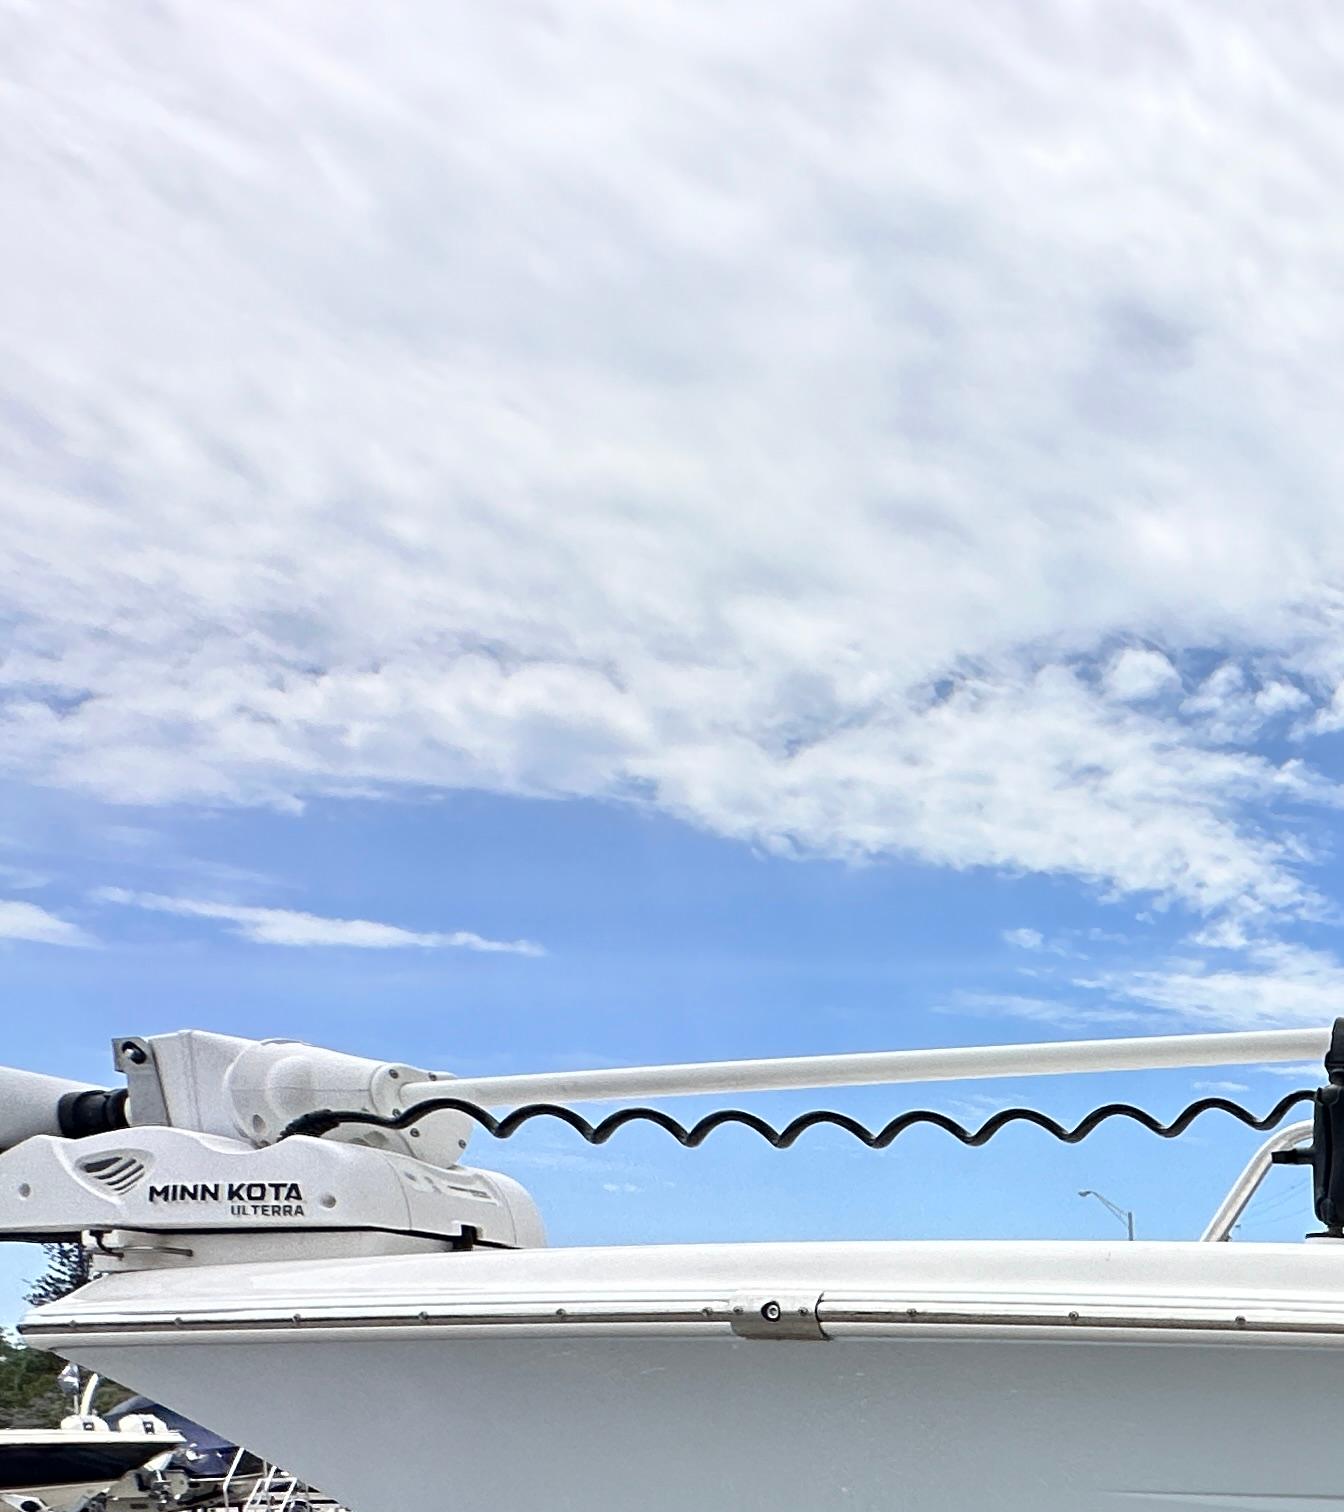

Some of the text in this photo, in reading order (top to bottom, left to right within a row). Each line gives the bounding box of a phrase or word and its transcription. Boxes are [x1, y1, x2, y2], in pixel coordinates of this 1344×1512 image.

[148, 1182, 303, 1202] MINN KOTA
[230, 1204, 305, 1217] ULTERRA
